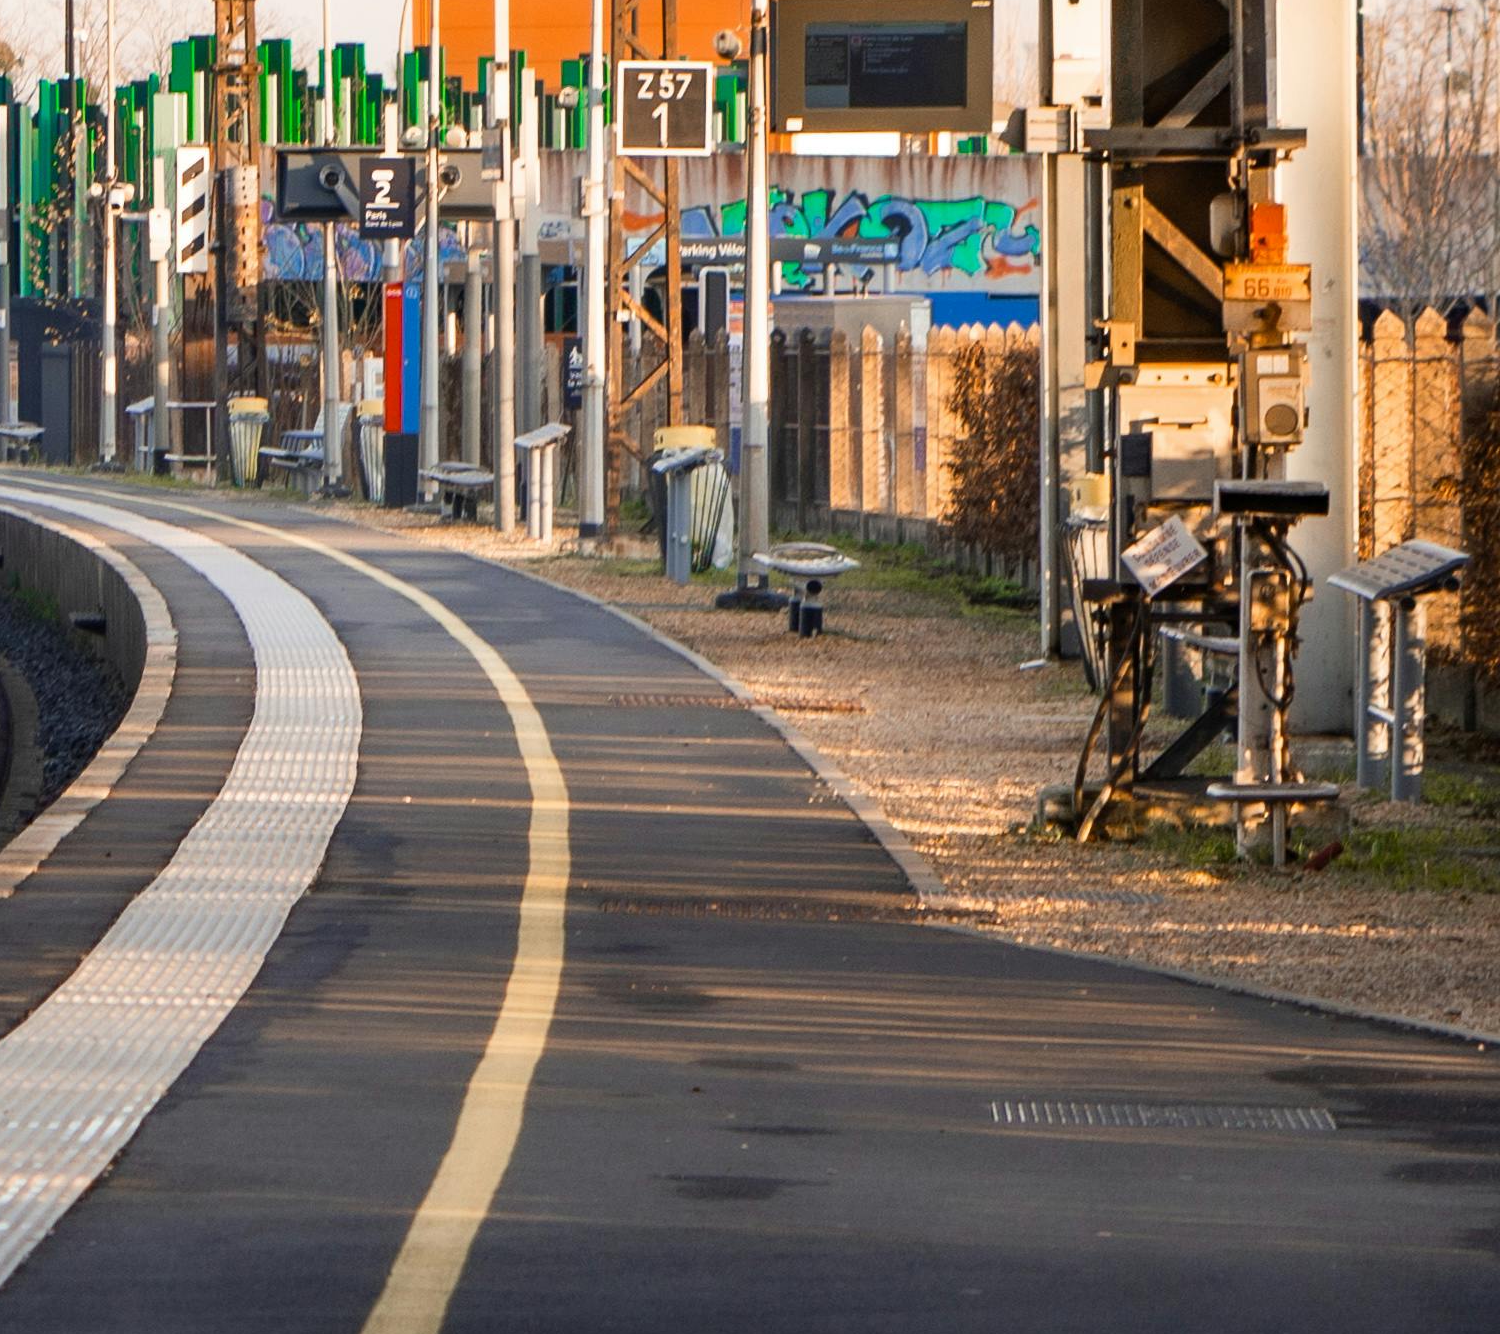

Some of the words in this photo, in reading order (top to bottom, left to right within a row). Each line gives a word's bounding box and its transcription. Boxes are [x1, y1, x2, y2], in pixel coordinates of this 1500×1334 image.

[637, 72, 654, 99] Z
[658, 72, 692, 99] 57
[651, 102, 668, 147] 1
[374, 180, 391, 204] 2
[365, 210, 387, 221] Paris
[1244, 278, 1270, 297] 66
